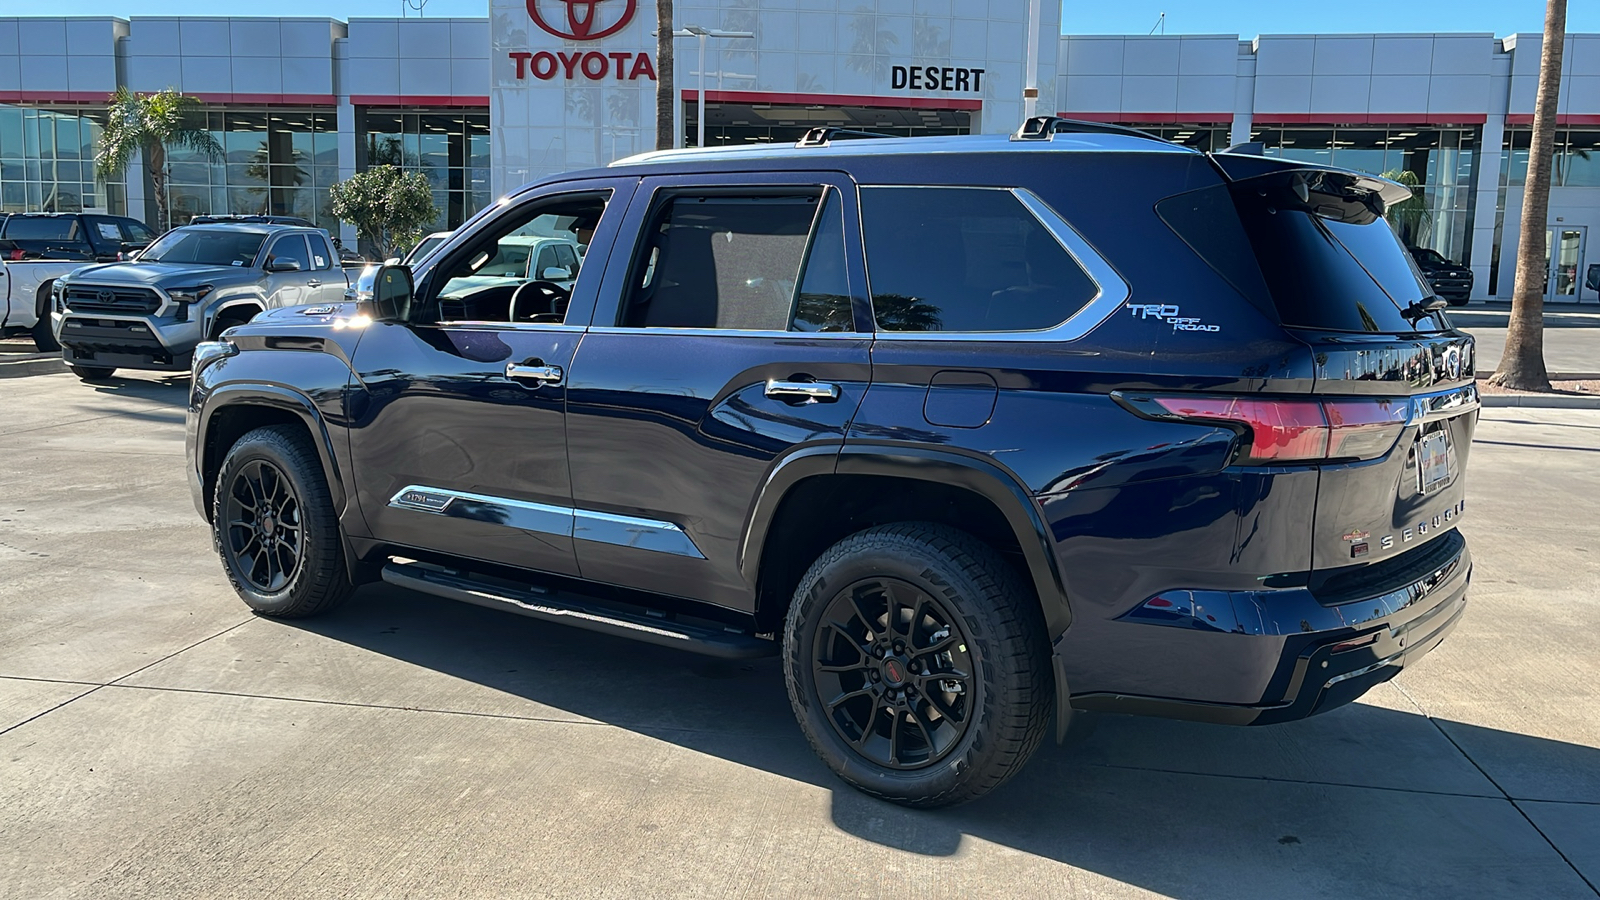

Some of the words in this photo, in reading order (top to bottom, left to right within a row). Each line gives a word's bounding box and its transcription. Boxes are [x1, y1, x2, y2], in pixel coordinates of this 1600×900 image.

[509, 51, 657, 81] TOYOTA
[891, 65, 985, 93] DESERT
[1126, 303, 1179, 319] TRD
[1173, 323, 1220, 332] ROAD
